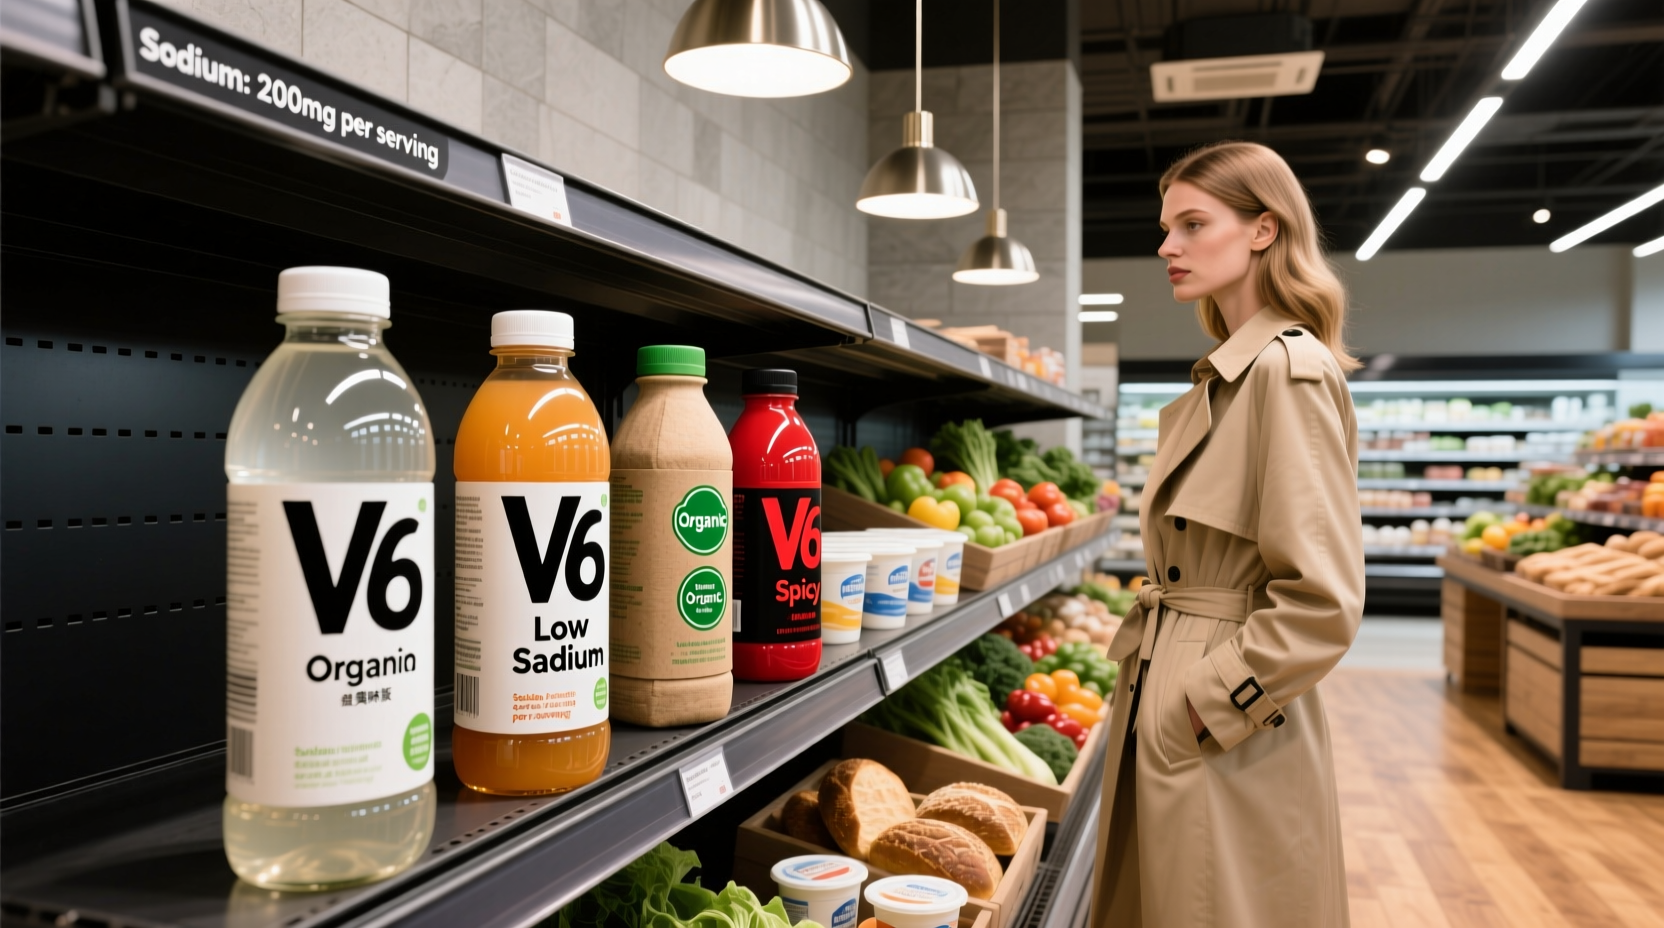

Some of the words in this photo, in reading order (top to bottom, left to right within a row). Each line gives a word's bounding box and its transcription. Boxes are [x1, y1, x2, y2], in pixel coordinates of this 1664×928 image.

[139, 26, 251, 95] Sodium:
[256, 72, 336, 133] 200mg
[341, 111, 373, 137] per
[376, 125, 439, 170] serving
[282, 500, 423, 635] V6
[501, 495, 605, 603] V6
[762, 497, 821, 570] V6
[534, 616, 589, 641] Low
[775, 577, 821, 608] Spicy
[512, 640, 604, 674] Sadium
